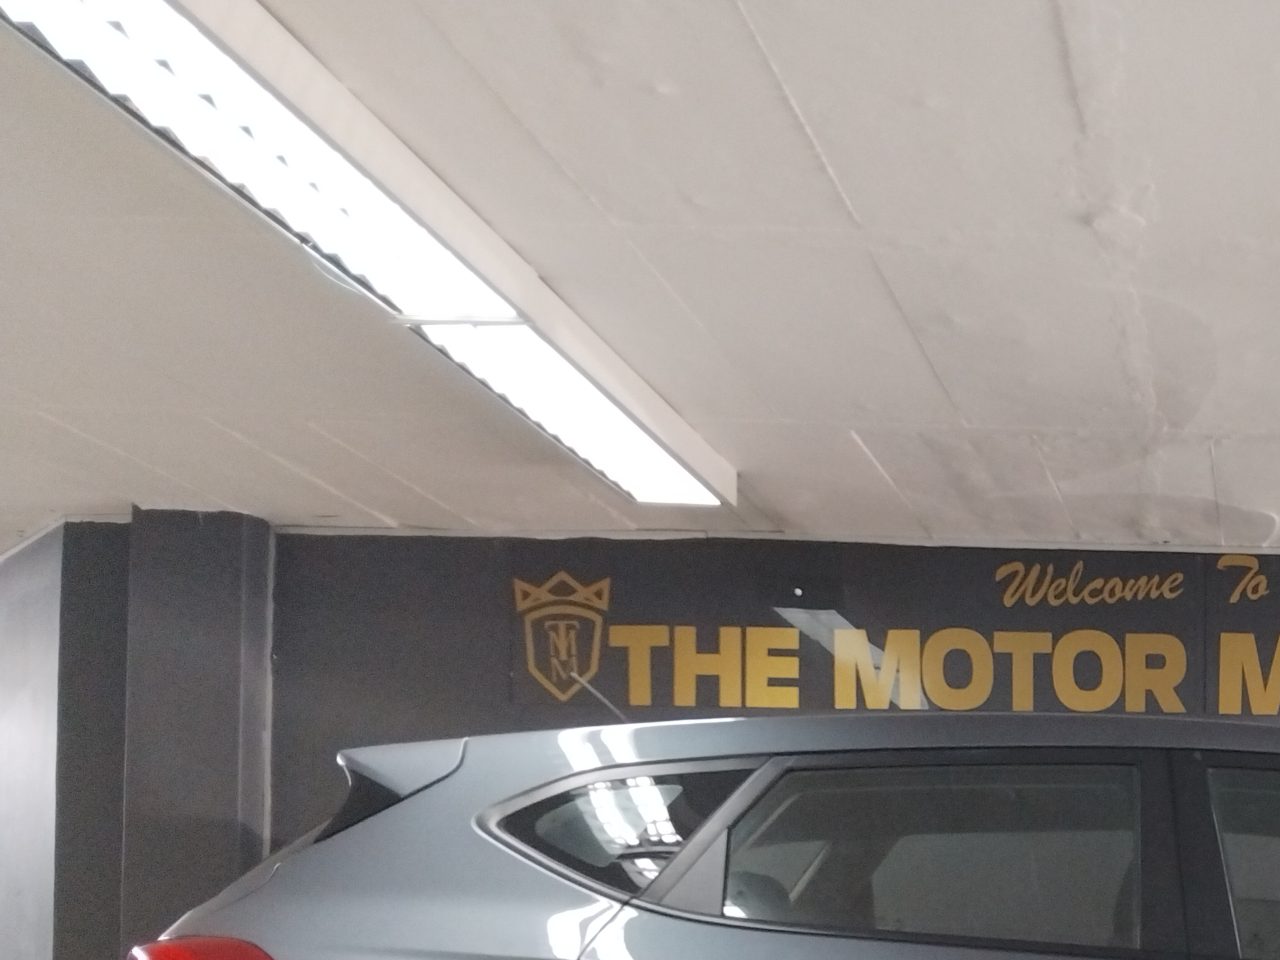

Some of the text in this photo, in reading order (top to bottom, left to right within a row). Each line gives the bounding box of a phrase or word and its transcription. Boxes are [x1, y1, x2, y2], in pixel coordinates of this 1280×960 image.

[996, 555, 1269, 608] Welcome To
[609, 625, 800, 709] THE
[834, 628, 1187, 713] MOTOR
